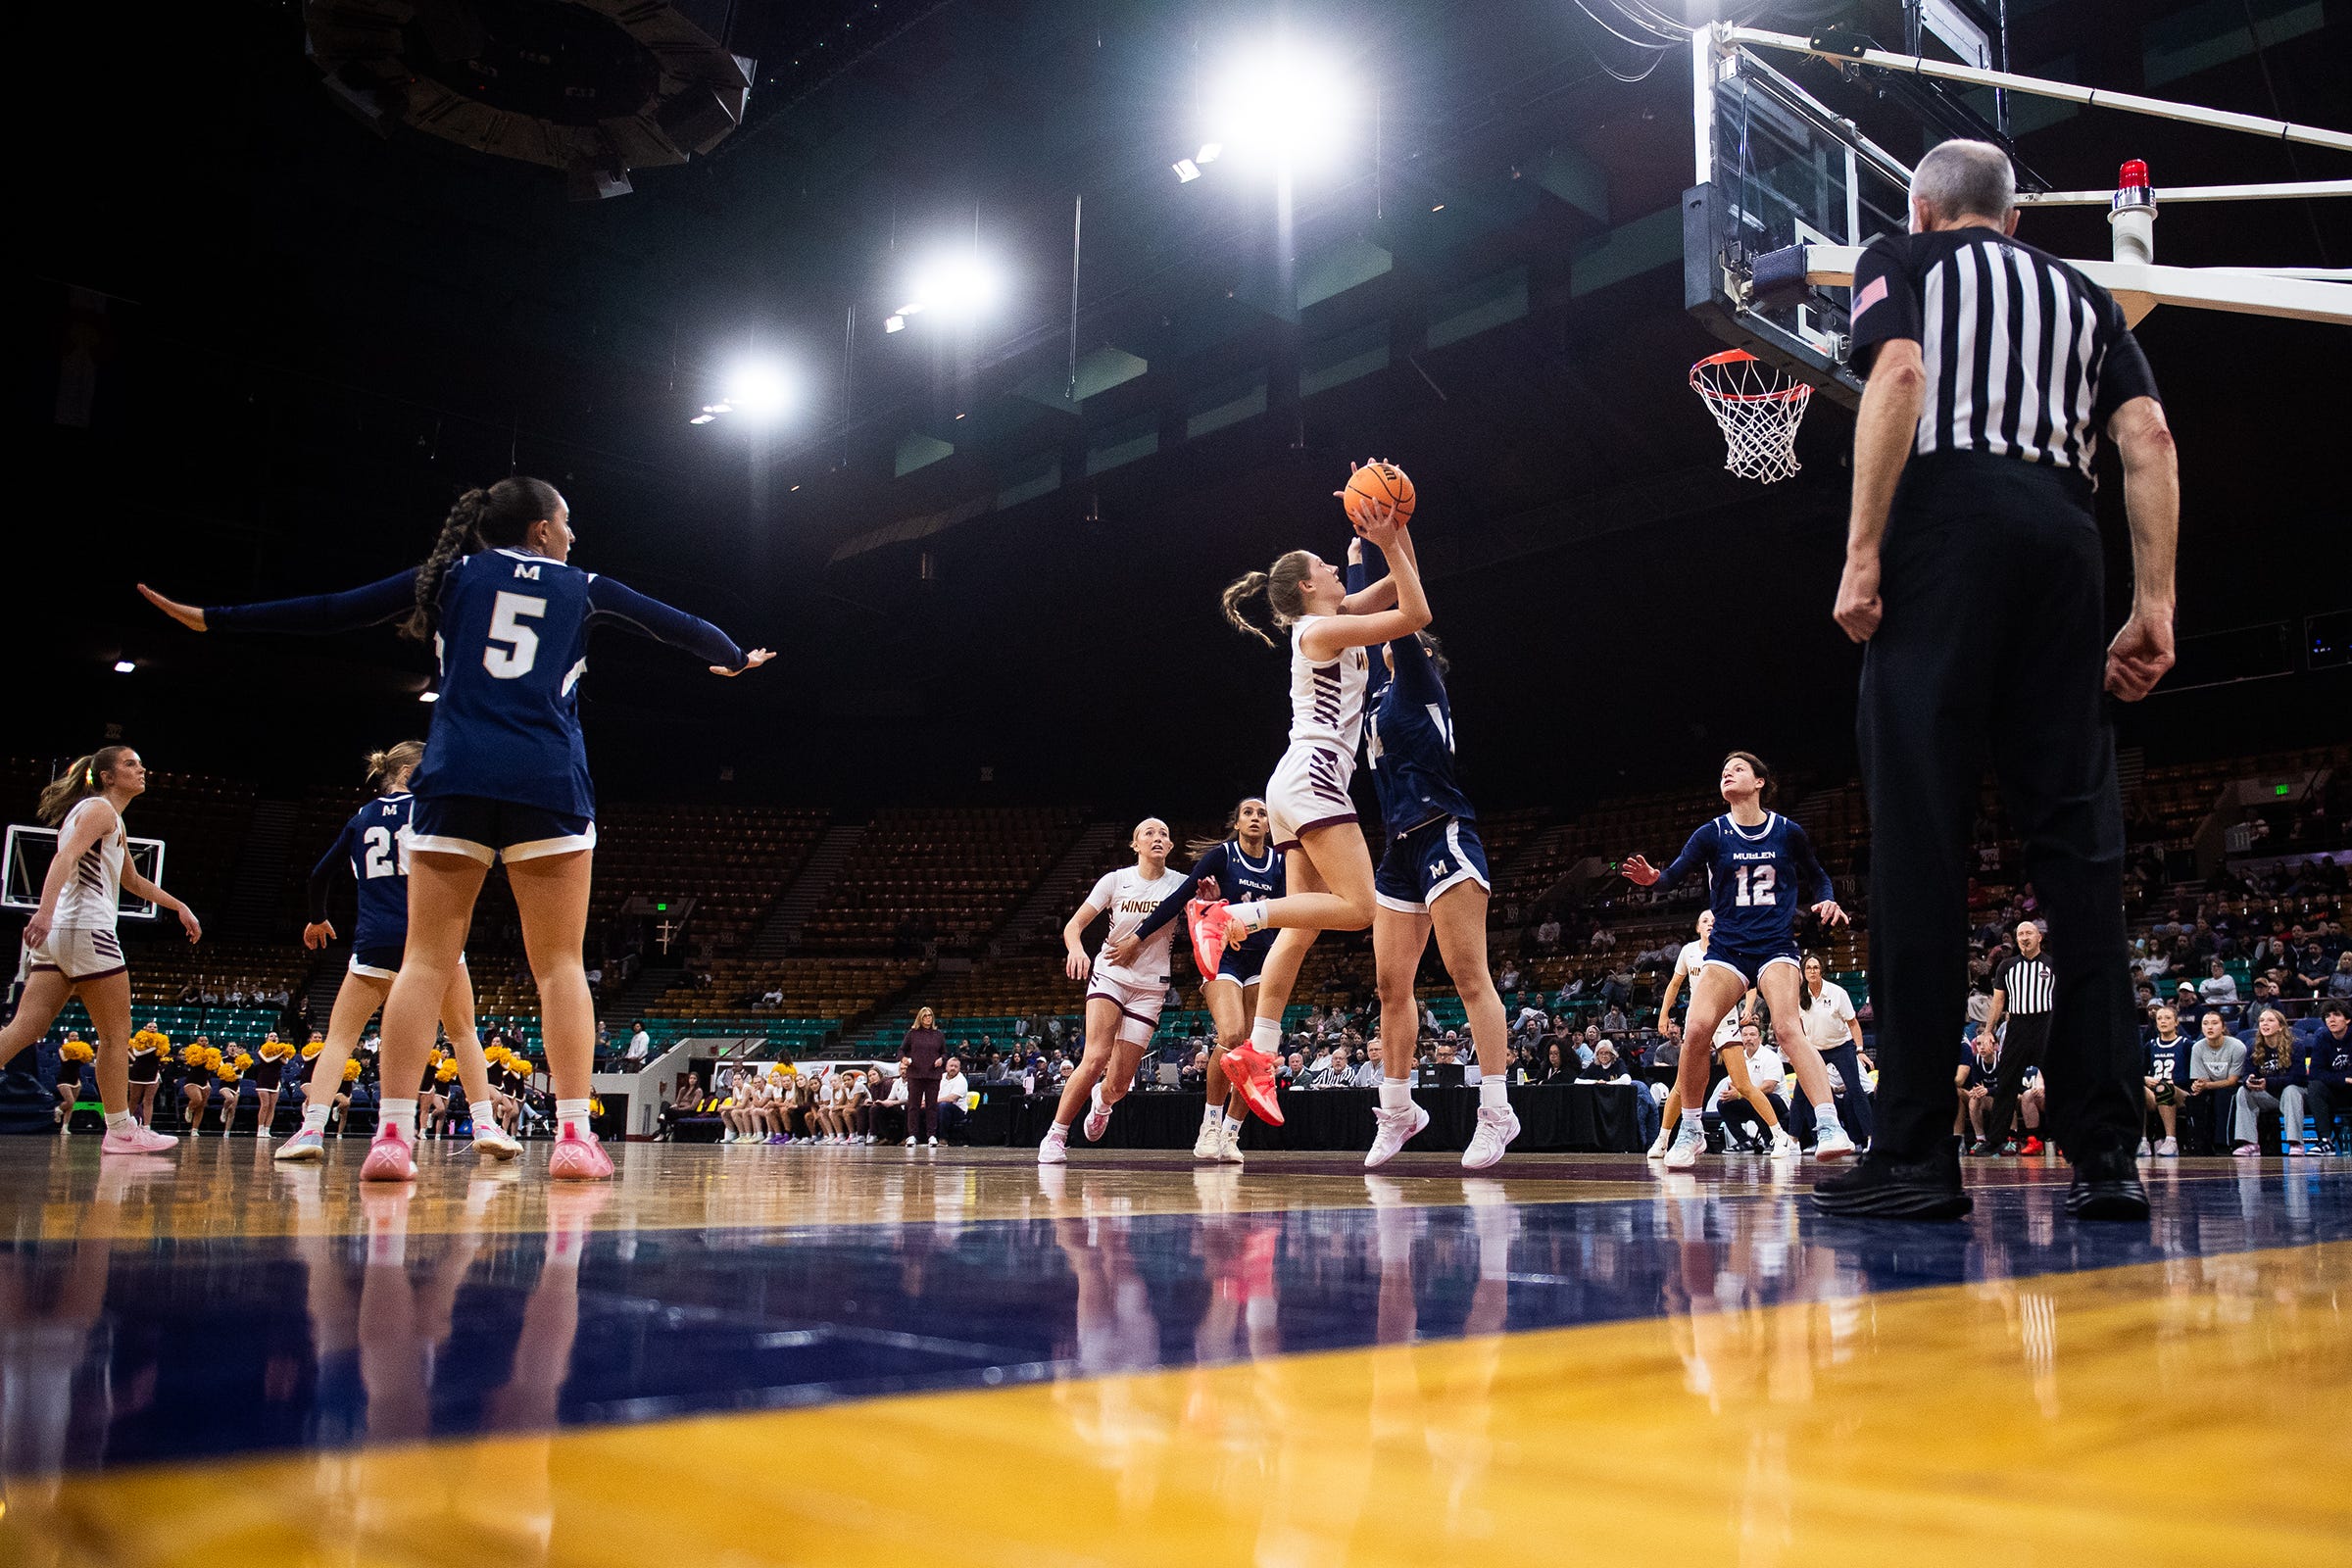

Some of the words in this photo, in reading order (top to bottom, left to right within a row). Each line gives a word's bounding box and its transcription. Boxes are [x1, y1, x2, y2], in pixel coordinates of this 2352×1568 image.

[514, 564, 541, 581] M
[482, 590, 548, 679] 5
[382, 805, 398, 816] M
[364, 826, 410, 879] 21
[1733, 851, 1776, 860] MULLEN
[1429, 859, 1448, 880] M
[1735, 864, 1777, 906] 12
[1120, 901, 1164, 913] WINDS
[1506, 907, 1519, 920] 109
[2153, 1058, 2176, 1081] 22
[2022, 1075, 2036, 1089] M
